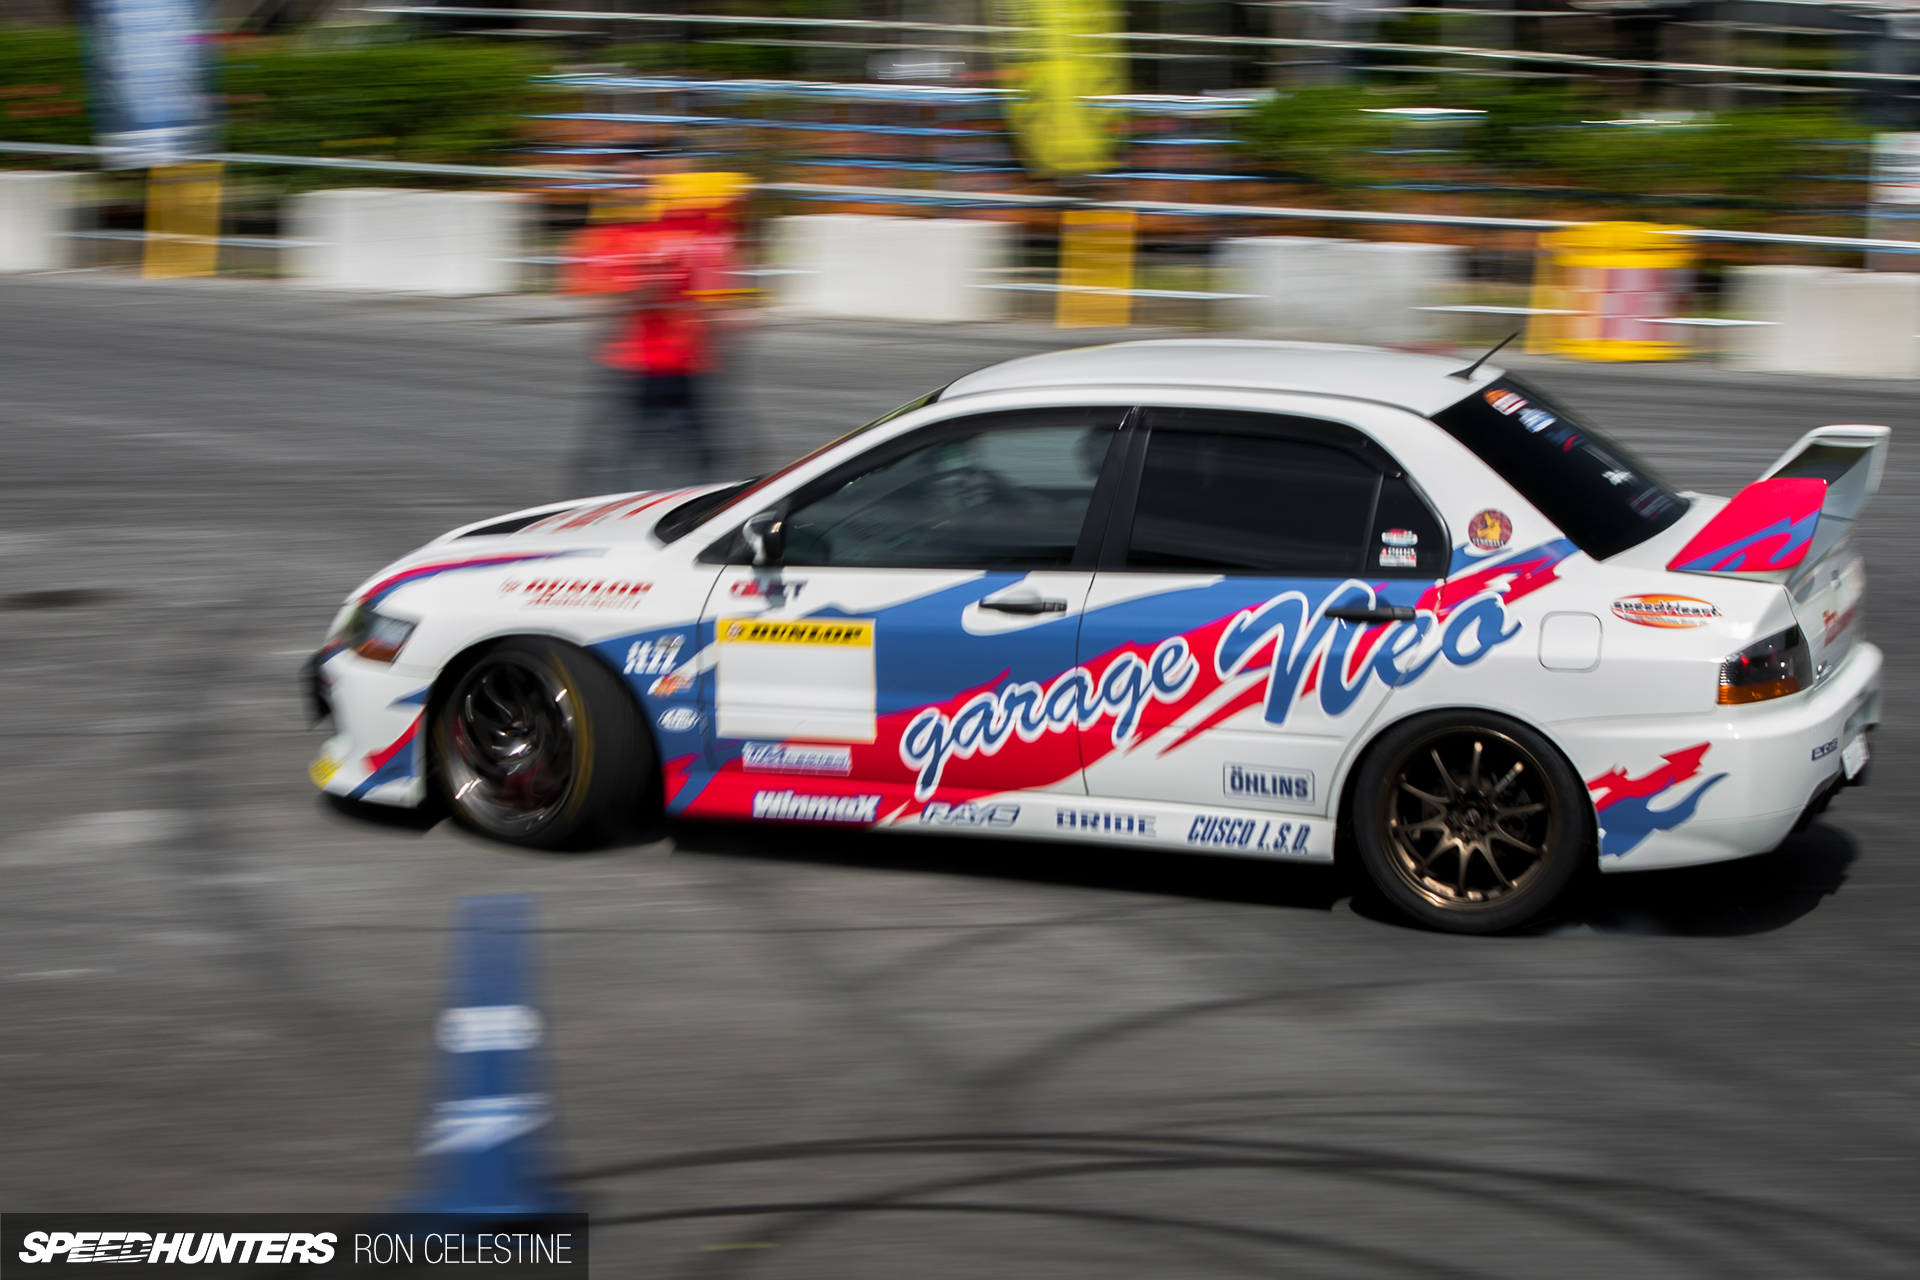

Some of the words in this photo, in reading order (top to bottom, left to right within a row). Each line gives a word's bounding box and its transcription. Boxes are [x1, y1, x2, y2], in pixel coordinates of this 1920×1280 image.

[521, 577, 655, 598] DUNLOP
[749, 622, 862, 644] DUNLOP
[900, 636, 1200, 800] garage
[1214, 579, 1524, 727] Neo
[1229, 765, 1309, 799] ÖHLINS
[919, 801, 1021, 826] RAYS
[1056, 807, 1156, 837] BRIDE
[1187, 814, 1256, 849] CUSCO
